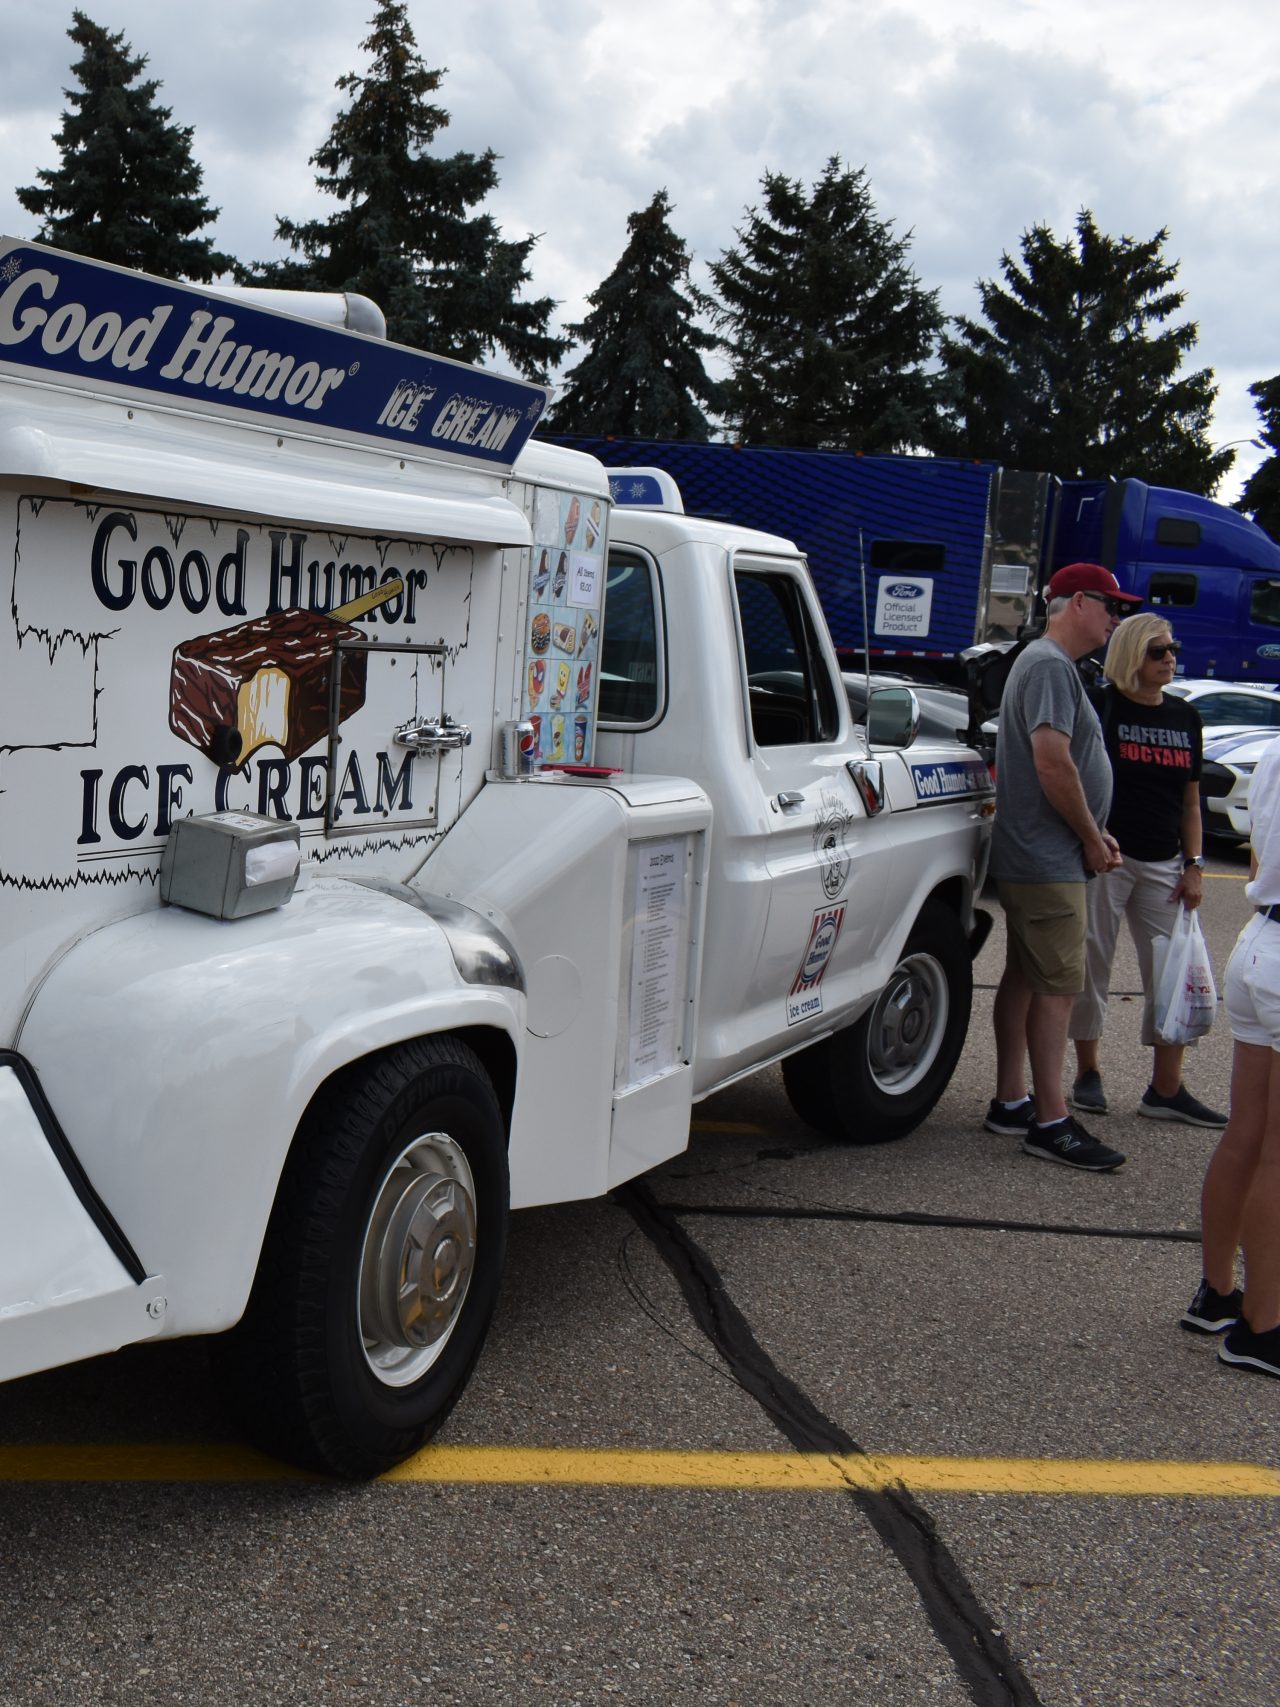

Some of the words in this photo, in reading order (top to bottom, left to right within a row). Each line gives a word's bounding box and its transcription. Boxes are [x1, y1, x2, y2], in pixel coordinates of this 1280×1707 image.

[376, 378, 437, 432] ICE
[431, 393, 523, 451] CREAM
[91, 512, 251, 616] Good
[265, 530, 428, 625] Humor
[891, 584, 918, 597] Ford
[883, 613, 923, 622] Licensed
[884, 602, 916, 612] Official
[882, 622, 918, 632] Product
[1117, 724, 1191, 748] CAFFEINE
[1127, 743, 1191, 768] OCTANE
[914, 768, 940, 796] Good
[77, 763, 193, 844] ICE
[214, 750, 418, 822] CREAM
[815, 932, 833, 949] Good
[789, 1003, 800, 1018] ice
[801, 997, 820, 1014] cream
